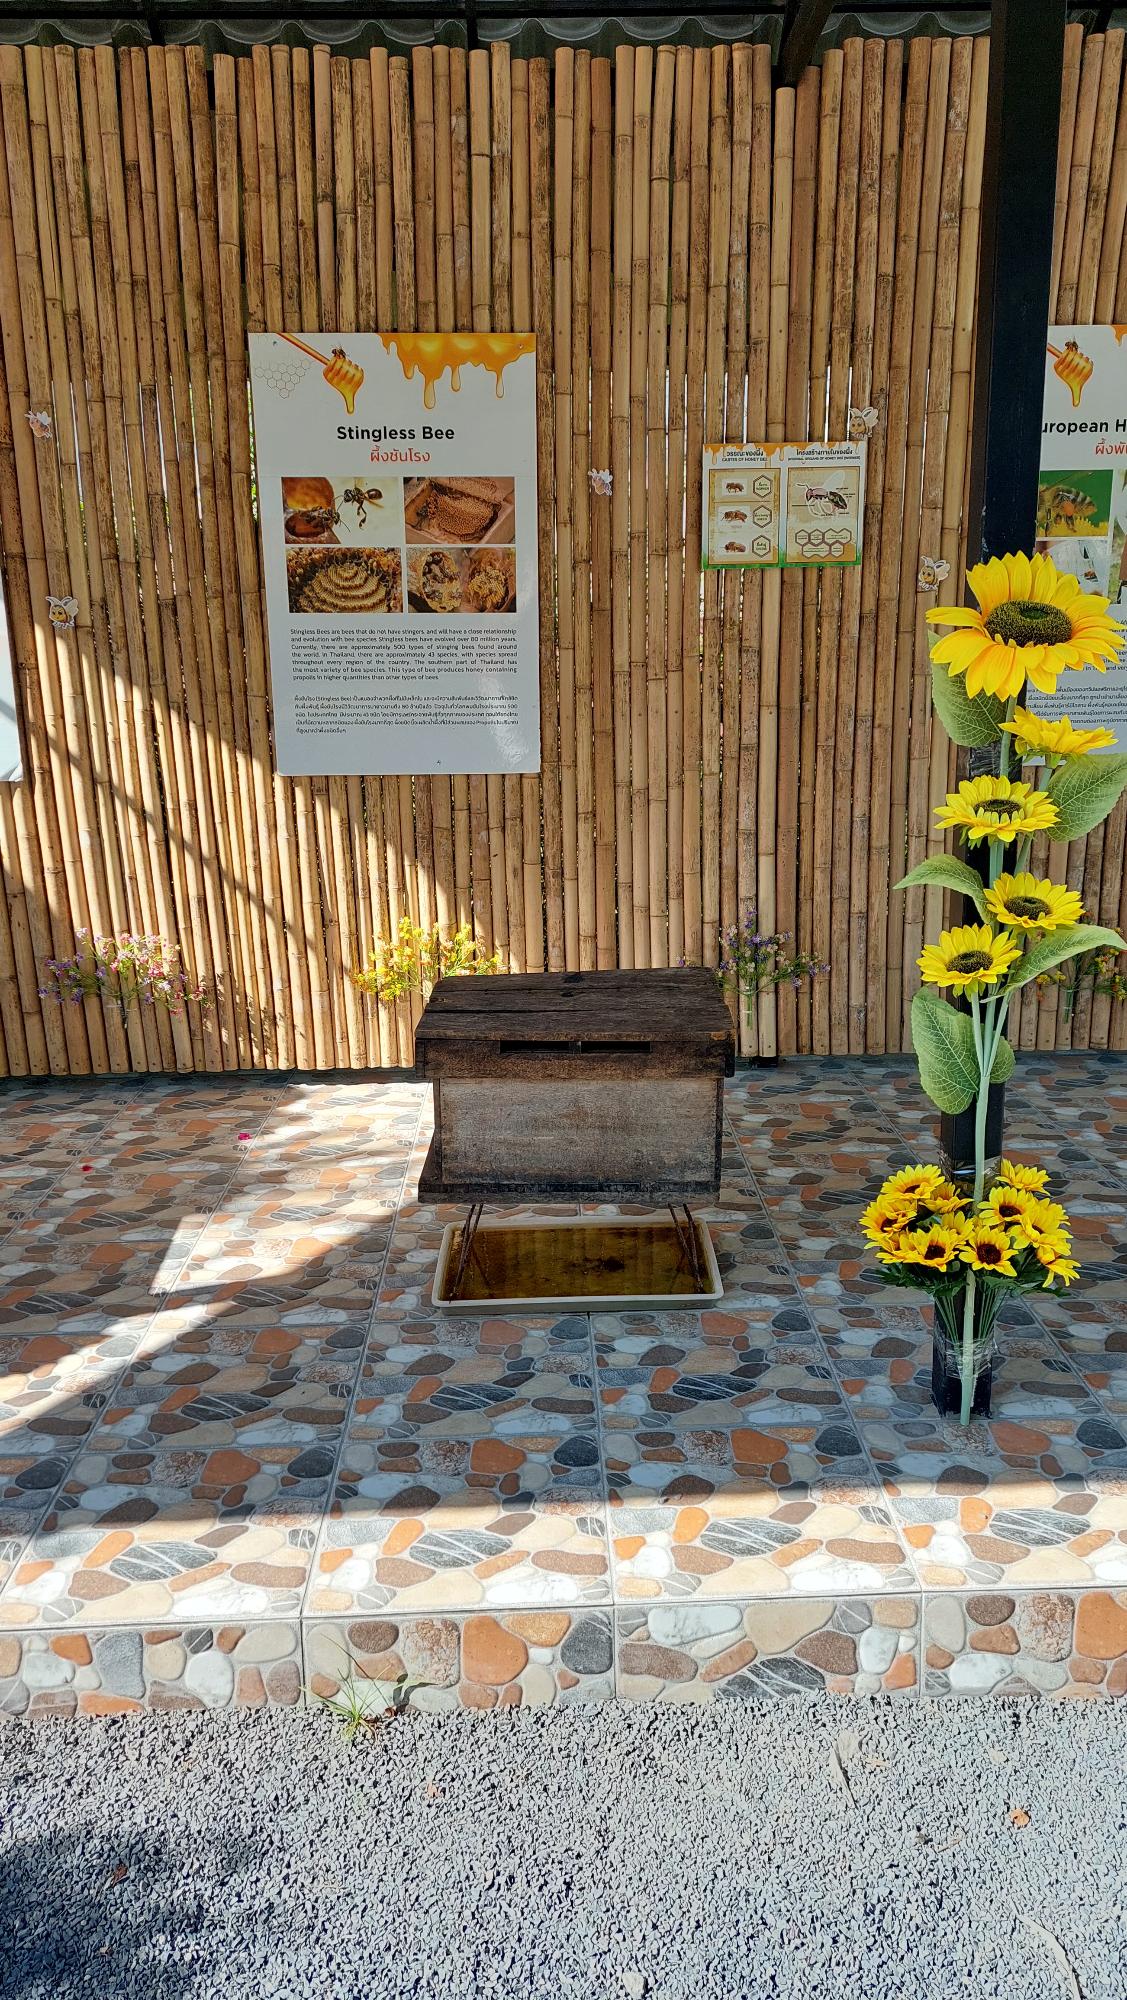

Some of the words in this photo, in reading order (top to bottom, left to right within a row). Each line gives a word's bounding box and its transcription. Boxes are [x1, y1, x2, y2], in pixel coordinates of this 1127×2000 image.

[336, 426, 416, 442] Stingless
[422, 426, 455, 440] Bee
[1042, 421, 1108, 436] uropean
[370, 444, 431, 462] ผึ้งชันโรง
[1095, 438, 1127, 455] ผึ้งพั
